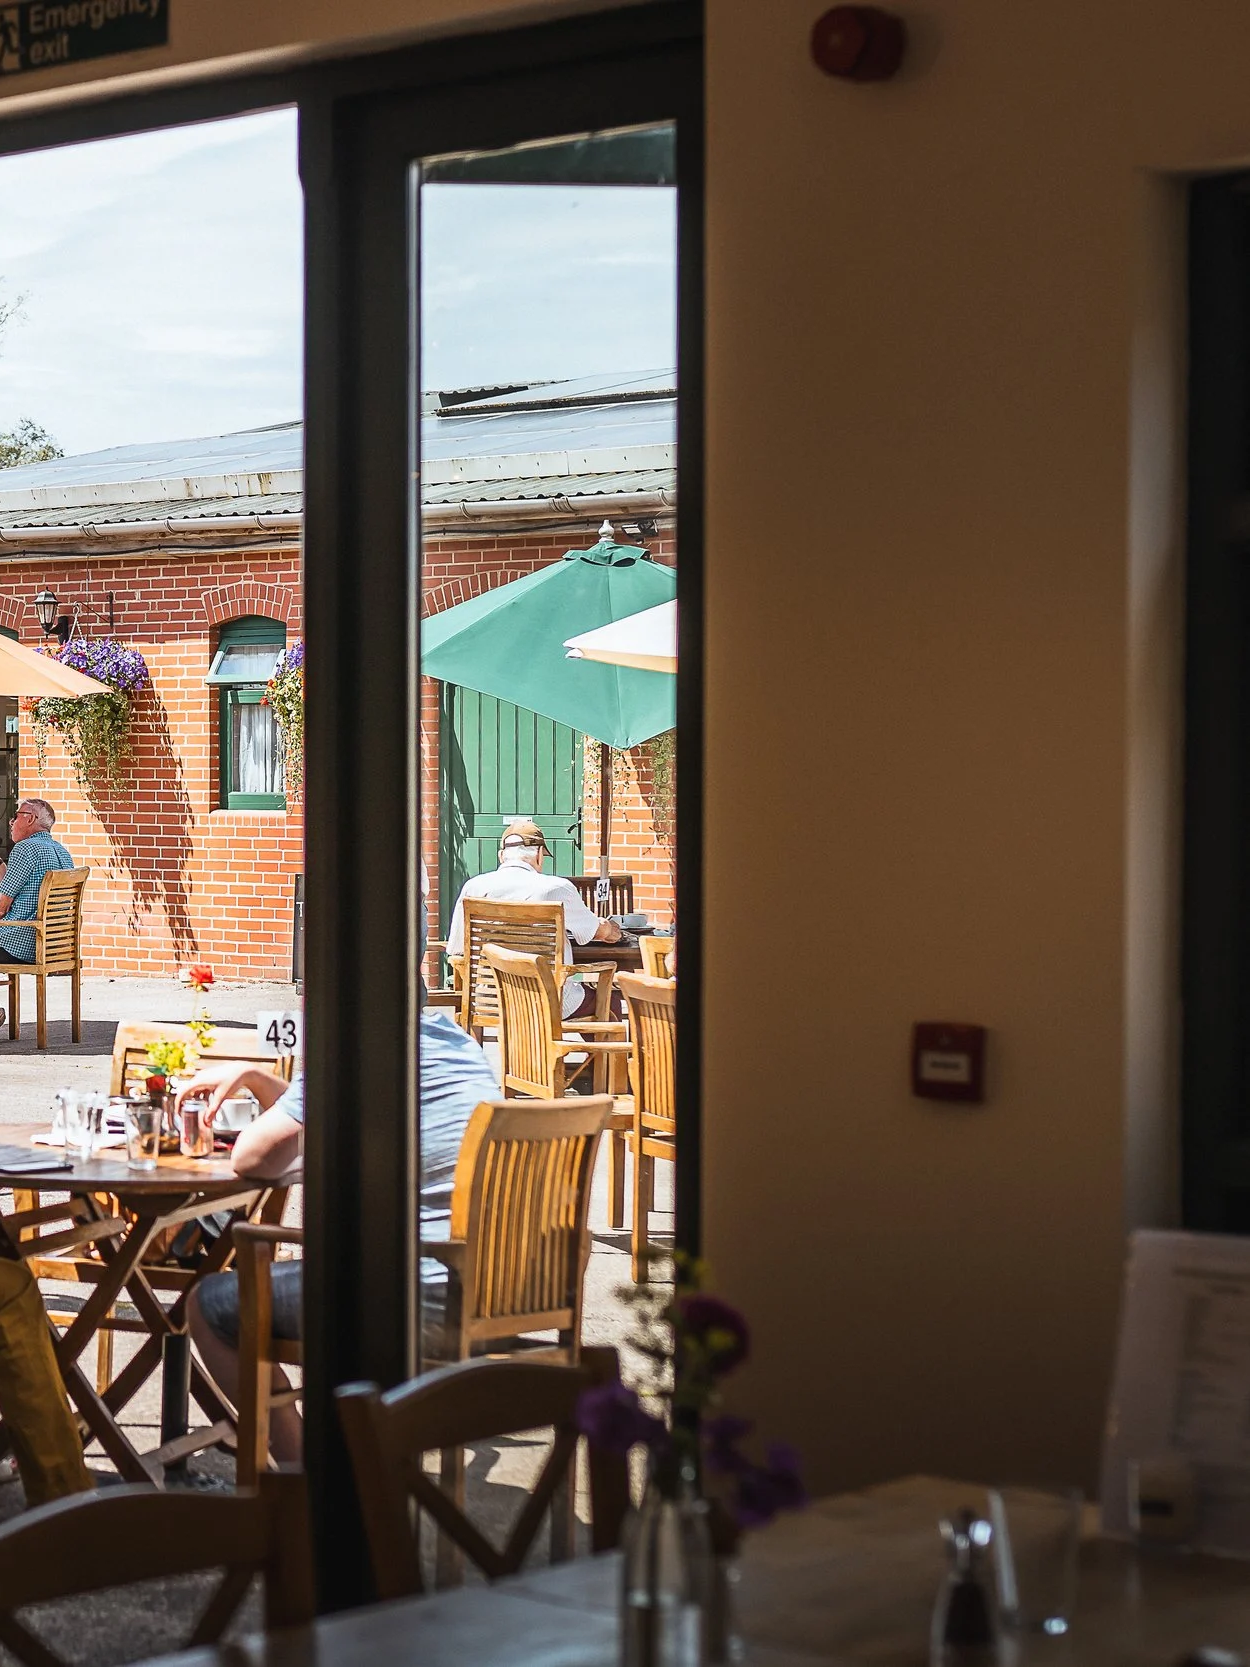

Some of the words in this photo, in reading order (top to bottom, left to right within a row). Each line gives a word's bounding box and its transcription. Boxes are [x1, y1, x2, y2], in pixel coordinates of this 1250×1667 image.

[29, 0, 158, 34] Emergency
[29, 33, 69, 64] exit
[598, 882, 608, 897] 34
[265, 1019, 297, 1048] 43
